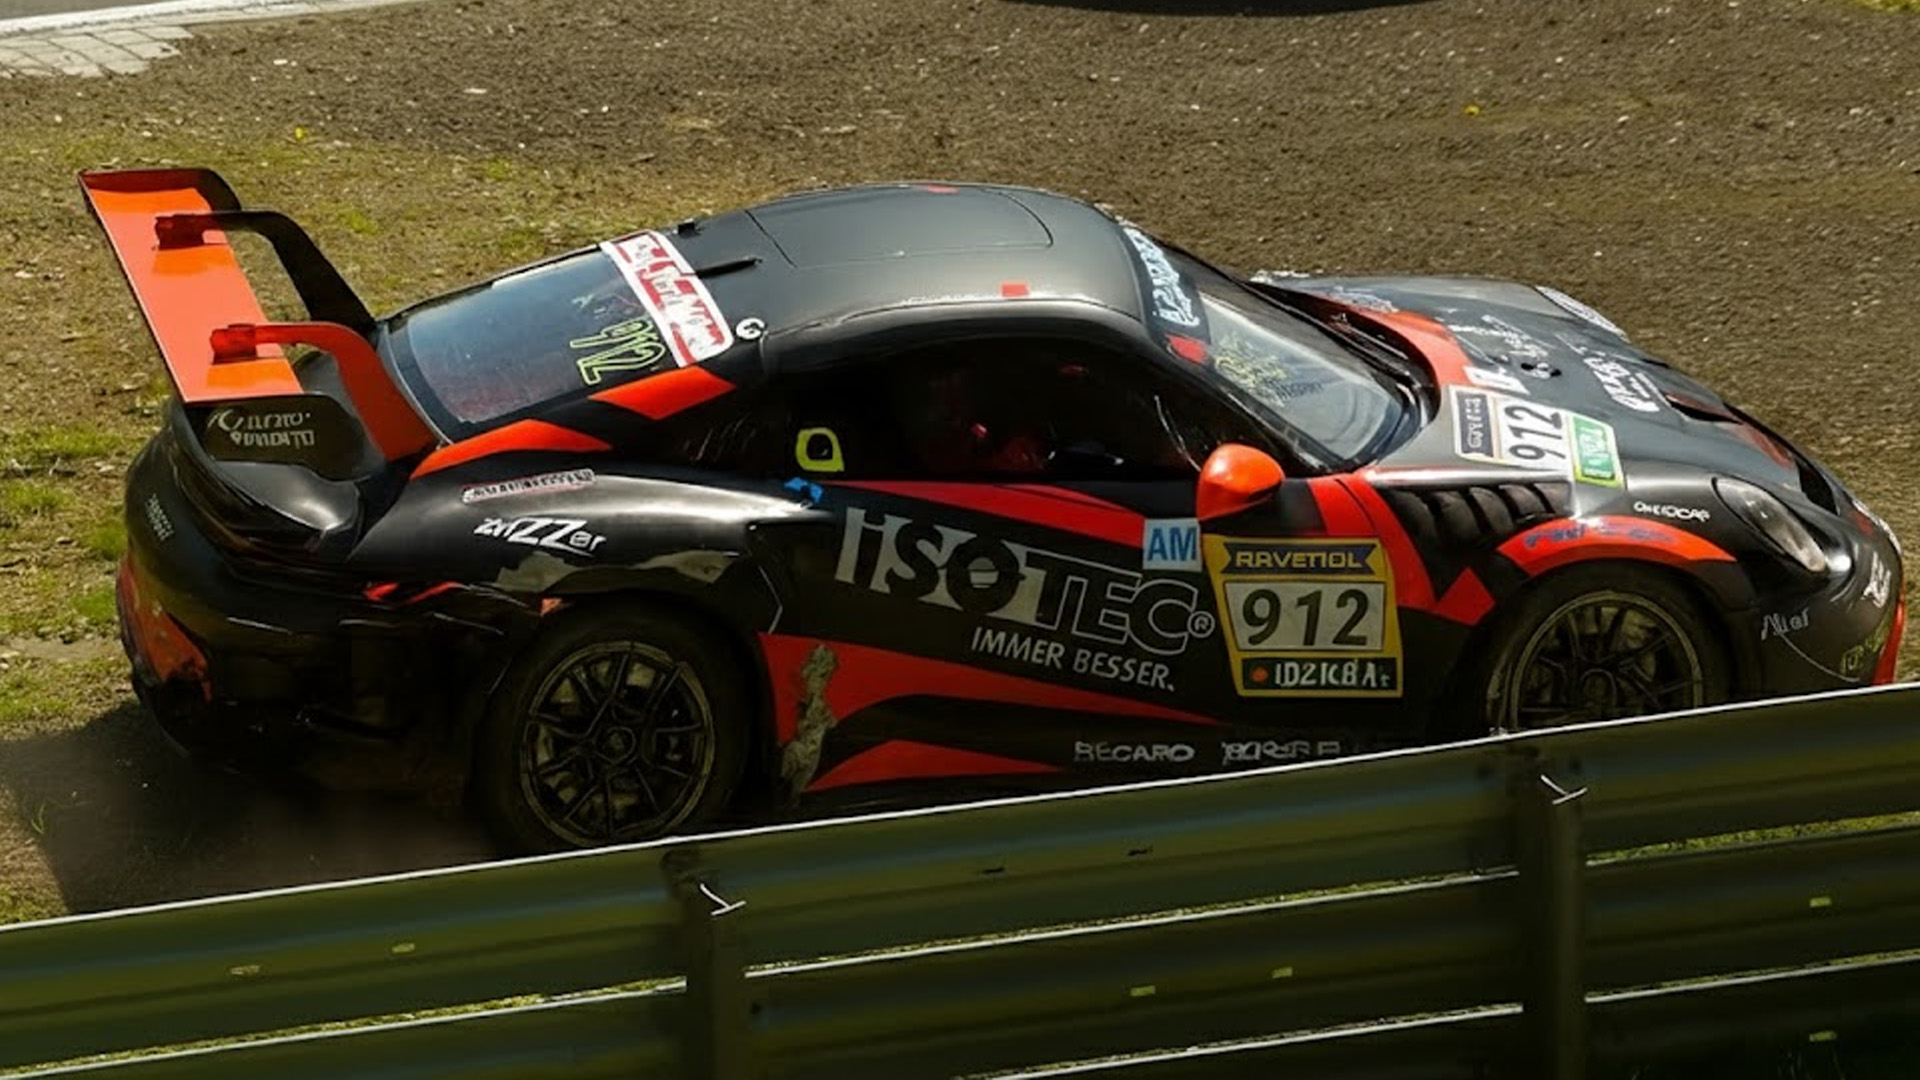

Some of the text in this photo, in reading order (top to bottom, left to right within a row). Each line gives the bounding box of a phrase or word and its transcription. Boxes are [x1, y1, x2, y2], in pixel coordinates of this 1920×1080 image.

[1504, 404, 1567, 461] 912
[1147, 526, 1198, 562] AM
[1242, 588, 1369, 647] 912
[971, 625, 1066, 670] IMMER
